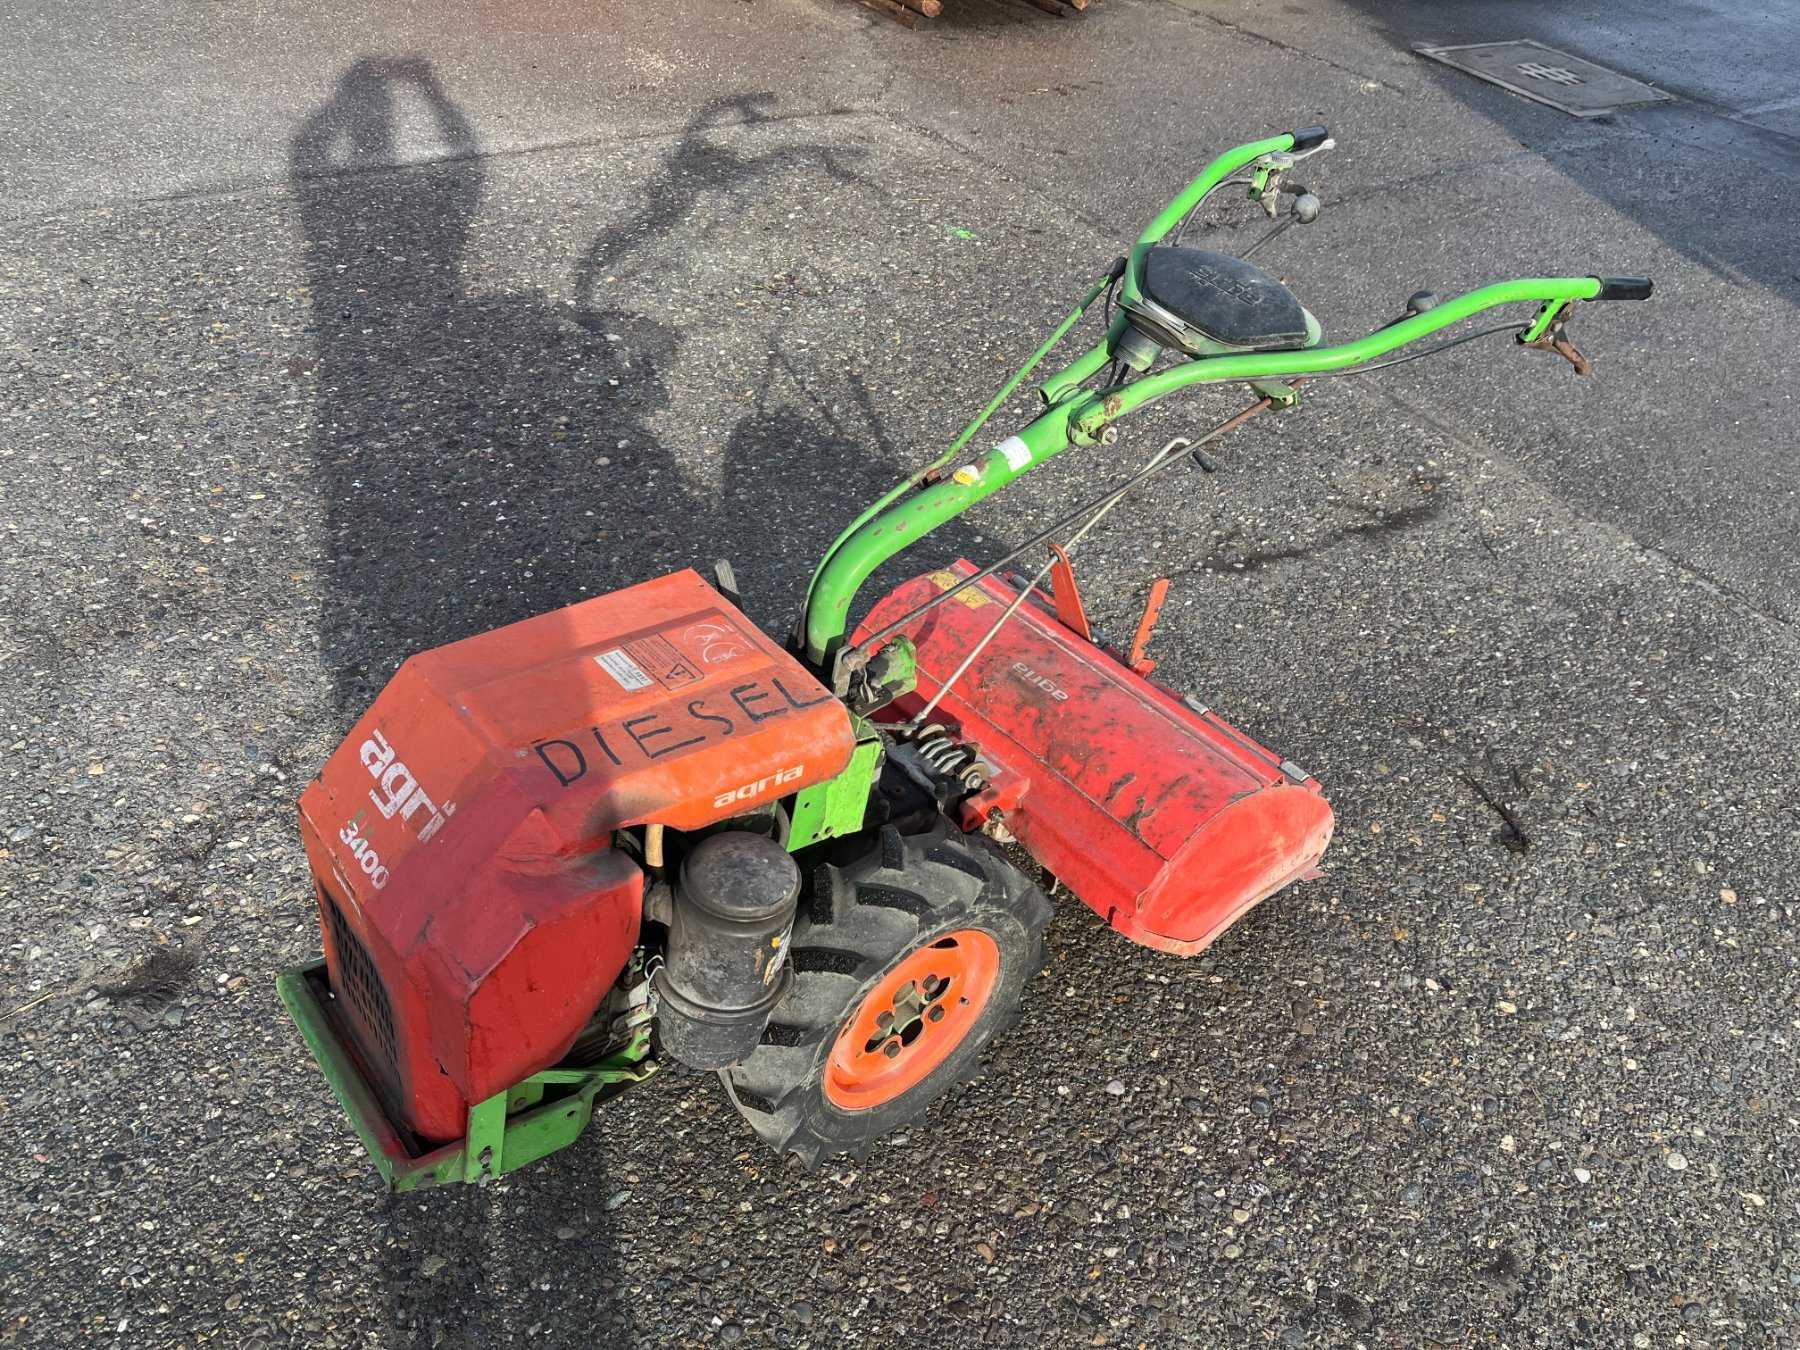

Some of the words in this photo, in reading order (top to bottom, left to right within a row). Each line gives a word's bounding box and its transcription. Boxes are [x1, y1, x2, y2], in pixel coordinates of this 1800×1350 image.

[1012, 661, 1069, 701] agria
[535, 676, 835, 786] DIESEL
[713, 764, 803, 809] agria
[339, 822, 389, 890] 3400
